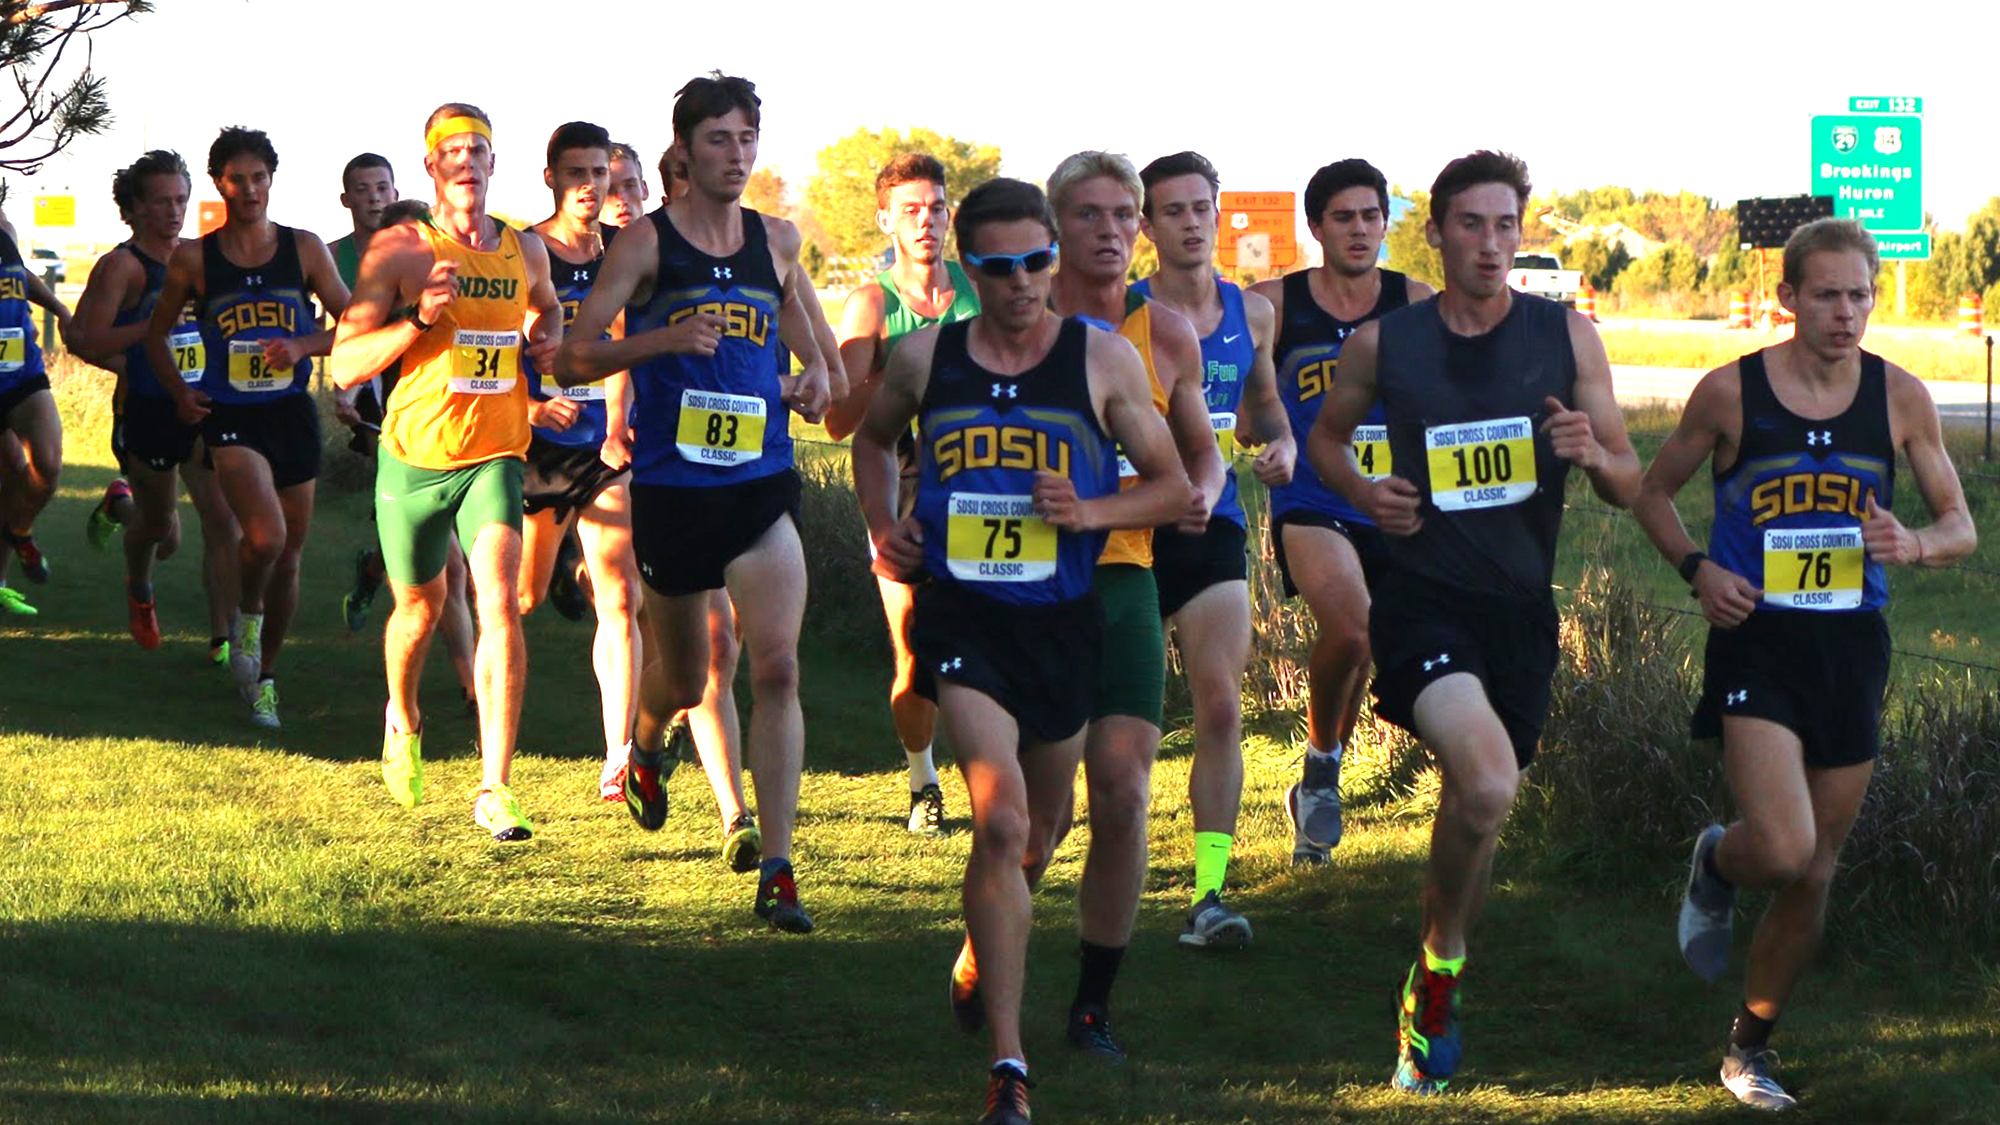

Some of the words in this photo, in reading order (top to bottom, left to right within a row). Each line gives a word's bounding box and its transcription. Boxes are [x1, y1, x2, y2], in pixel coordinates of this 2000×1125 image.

[1856, 100, 1880, 110] EXIT
[1888, 98, 1916, 112] 132
[1836, 134, 1855, 149] 29
[1820, 163, 1912, 182] Brookings
[1235, 196, 1256, 205] EXIT
[1263, 196, 1280, 205] 132
[1839, 186, 1894, 200] Huron
[1849, 206, 1855, 219] 1
[1859, 208, 1884, 218] MILE
[1878, 241, 1922, 253] Airport
[0, 277, 25, 300] SU
[457, 276, 518, 300] NDSU
[217, 301, 296, 339] SDSU
[458, 334, 474, 345] SDSU
[476, 335, 494, 346] CROSS
[495, 334, 517, 346] COUNTRY
[0, 340, 8, 360] 7
[176, 347, 197, 371] 78
[250, 355, 273, 378] 82
[474, 348, 501, 378] 34
[1207, 360, 1238, 382] Fun
[247, 380, 275, 389] CLASSIC
[470, 380, 499, 390] CLASSIC
[1298, 359, 1338, 402] SD
[562, 386, 591, 397] CLASSIC
[688, 395, 707, 408] SDSU
[708, 397, 731, 412] CROSS
[732, 400, 760, 415] COUNTRY
[706, 413, 738, 448] 83
[1212, 418, 1231, 429] OUNTRY
[1366, 430, 1387, 441] COUNT
[1434, 430, 1456, 447] SDSU
[1458, 427, 1485, 443] CROSS
[1487, 423, 1524, 441] COUNTRY
[701, 447, 737, 462] CLASSIC
[933, 425, 1069, 482] SDSU
[1453, 443, 1512, 488] 100
[1464, 487, 1507, 503] CLASSIC
[1752, 473, 1875, 526] SDSU
[956, 499, 979, 514] SDSU
[981, 500, 1009, 516] CROSS
[1011, 501, 1041, 516] COUN
[983, 519, 1022, 559] 75
[1771, 535, 1793, 549] SDSU
[1794, 534, 1820, 549] CROSS
[1822, 533, 1856, 548] COUNTRY
[979, 562, 1024, 576] CLASSIC
[1797, 552, 1831, 590] 76
[1793, 592, 1833, 606] CLASSIC
